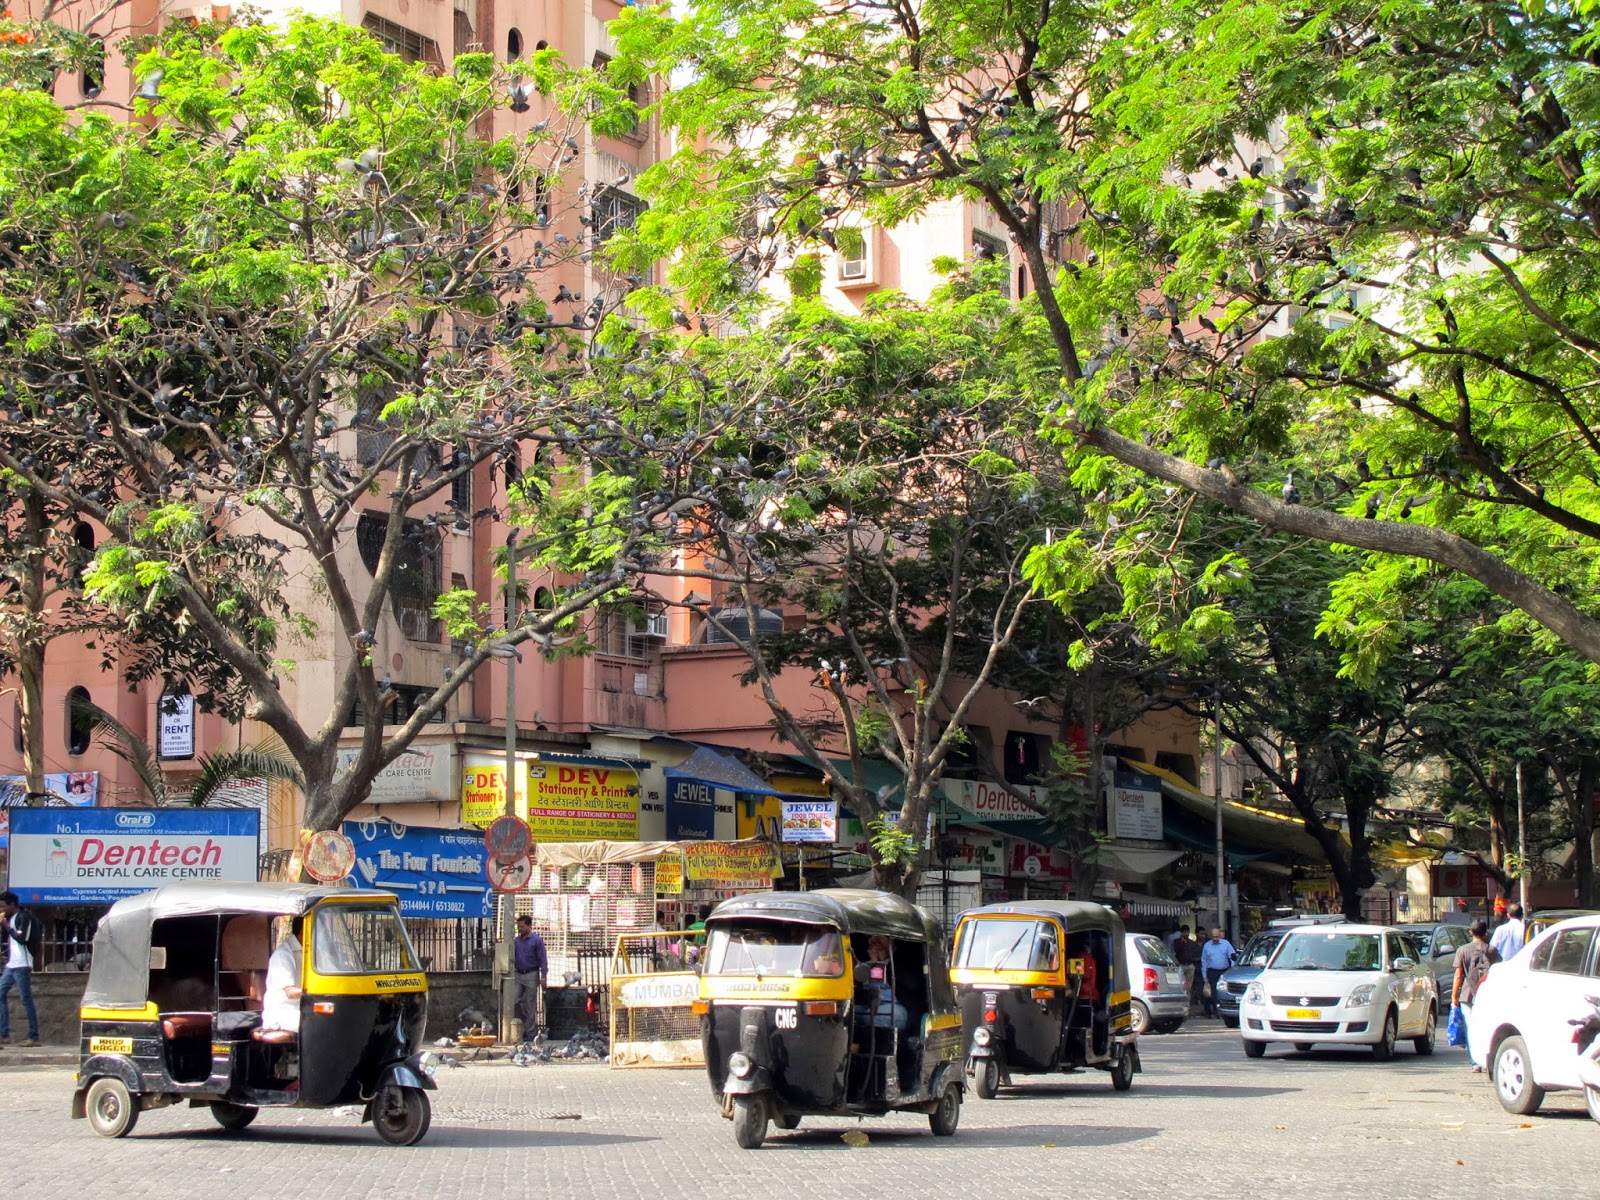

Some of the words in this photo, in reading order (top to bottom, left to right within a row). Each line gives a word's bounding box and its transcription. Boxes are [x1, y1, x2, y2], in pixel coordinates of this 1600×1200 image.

[165, 725, 190, 735] RENT
[407, 768, 432, 776] CENTRE
[559, 767, 611, 785] DEV
[538, 782, 588, 798] Stationery
[591, 786, 599, 797] &
[601, 785, 628, 798] Prints
[647, 791, 659, 800] VEG
[674, 783, 712, 802] JEWEL
[466, 789, 497, 805] Stationery
[547, 809, 566, 817] RANGE
[577, 811, 611, 819] STATIONERY
[642, 803, 653, 812] NON
[654, 804, 665, 813] VEG
[714, 804, 734, 813] CHINESE
[787, 803, 832, 813] JEWEL
[119, 815, 152, 825] Oral-B
[596, 820, 615, 828] Computer
[616, 821, 636, 829] Stationery
[56, 822, 80, 834] No.1
[77, 838, 222, 866] Dentech
[378, 849, 401, 870] The
[403, 851, 428, 872] Four
[688, 857, 700, 868] Full
[700, 857, 717, 870] Range
[717, 856, 724, 868] Of
[725, 857, 751, 871] Stationery
[77, 867, 130, 877] DENTAL
[133, 867, 168, 877] CARE
[171, 867, 222, 877] CENTRE
[419, 881, 446, 894] SPA
[401, 900, 430, 910] 65144044
[436, 902, 465, 912] 65130022
[634, 983, 699, 1001] MUMBAI
[775, 1008, 797, 1029] CNG
